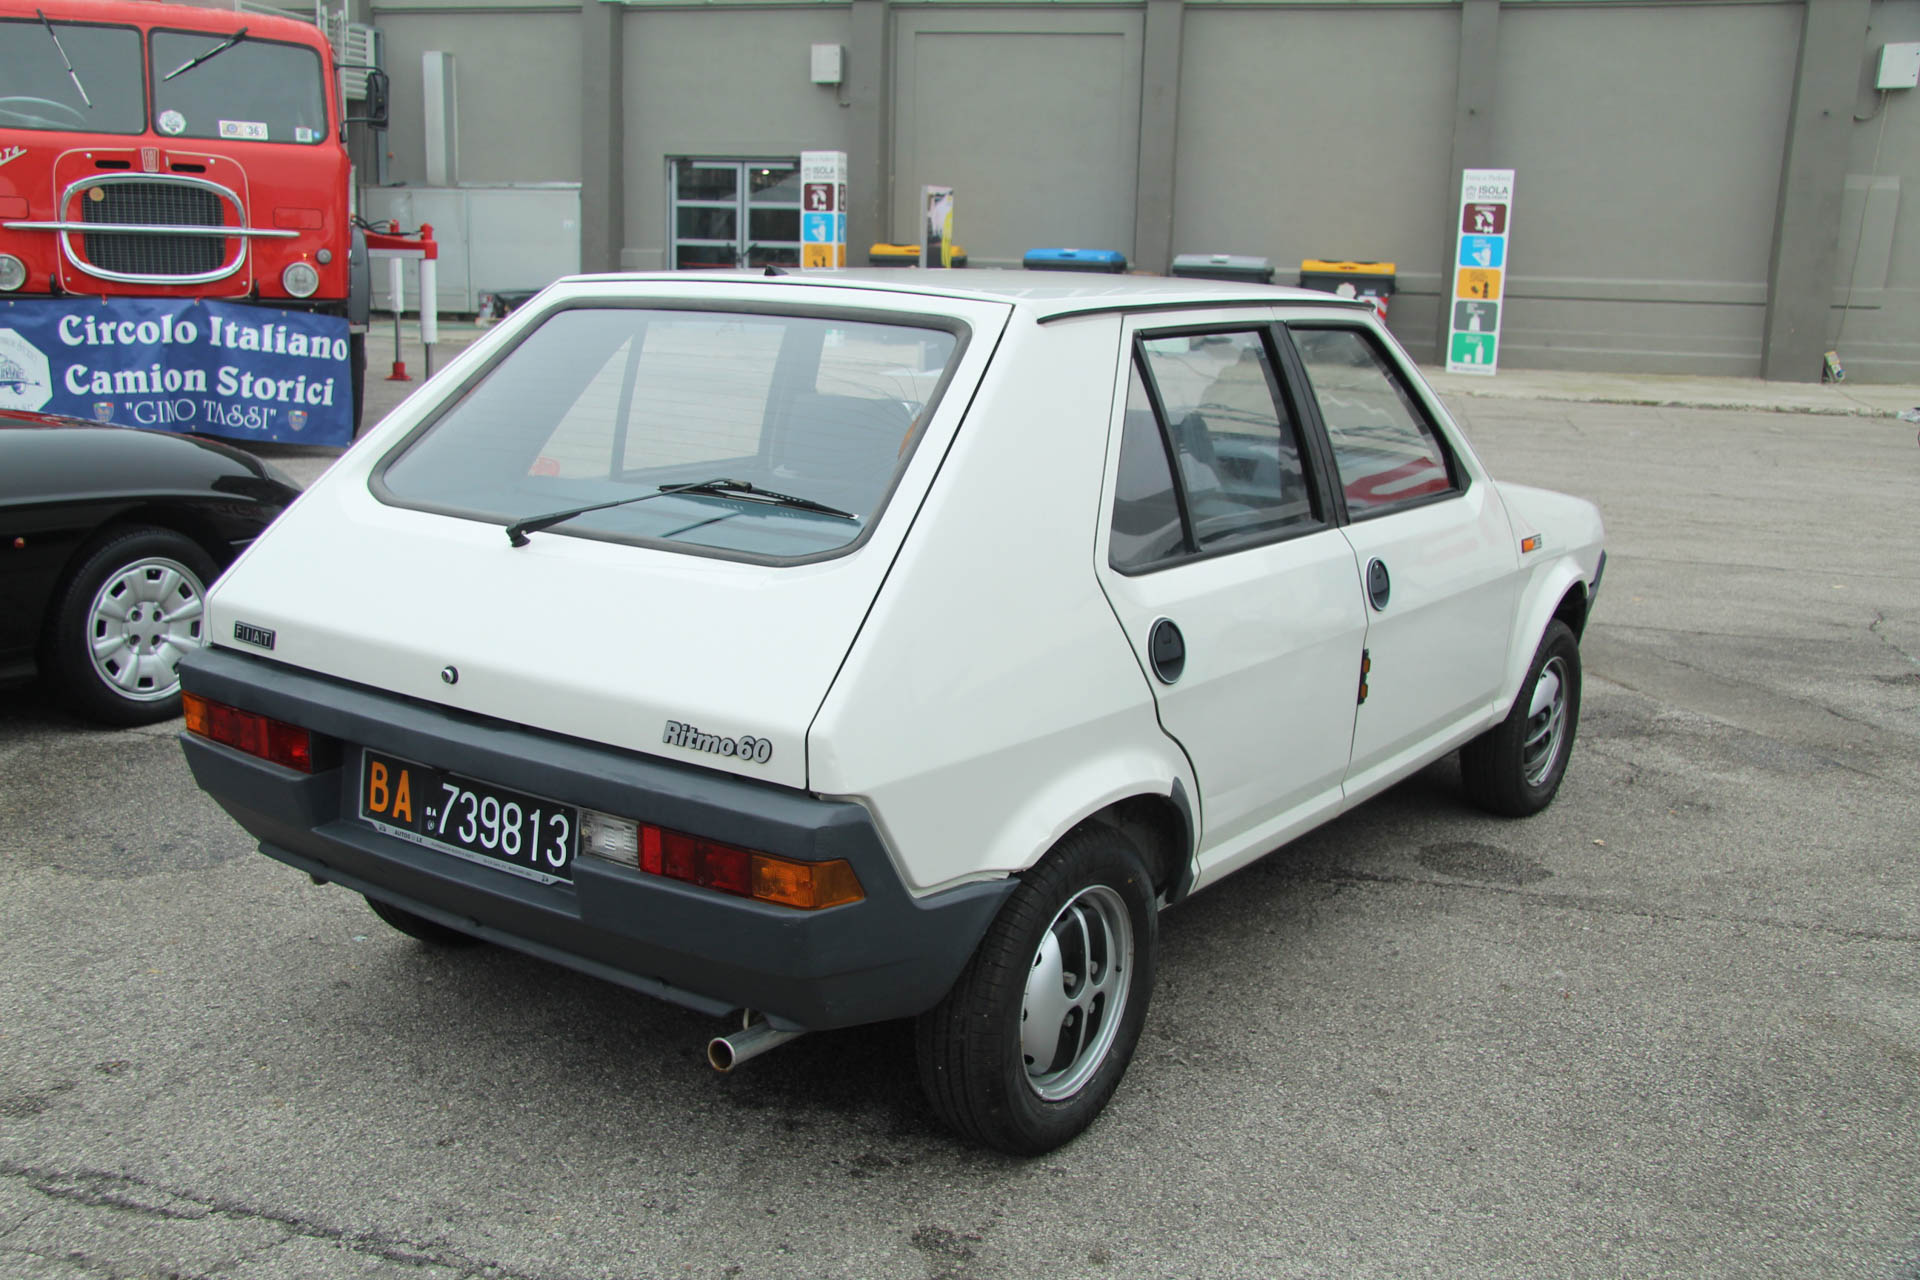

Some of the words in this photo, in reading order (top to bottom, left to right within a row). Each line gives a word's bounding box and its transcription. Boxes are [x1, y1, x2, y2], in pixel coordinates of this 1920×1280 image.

[813, 166, 834, 175] ISOLA
[1479, 185, 1508, 195] ISOLA
[59, 314, 198, 346] Circolo
[209, 316, 348, 361] Italiano
[65, 363, 207, 395] Camion
[216, 365, 334, 406] Storici
[125, 399, 196, 424] "GINO
[203, 400, 277, 430] TASSI"
[235, 623, 271, 647] FIAT
[369, 761, 412, 822] BA
[438, 782, 570, 868] 739813
